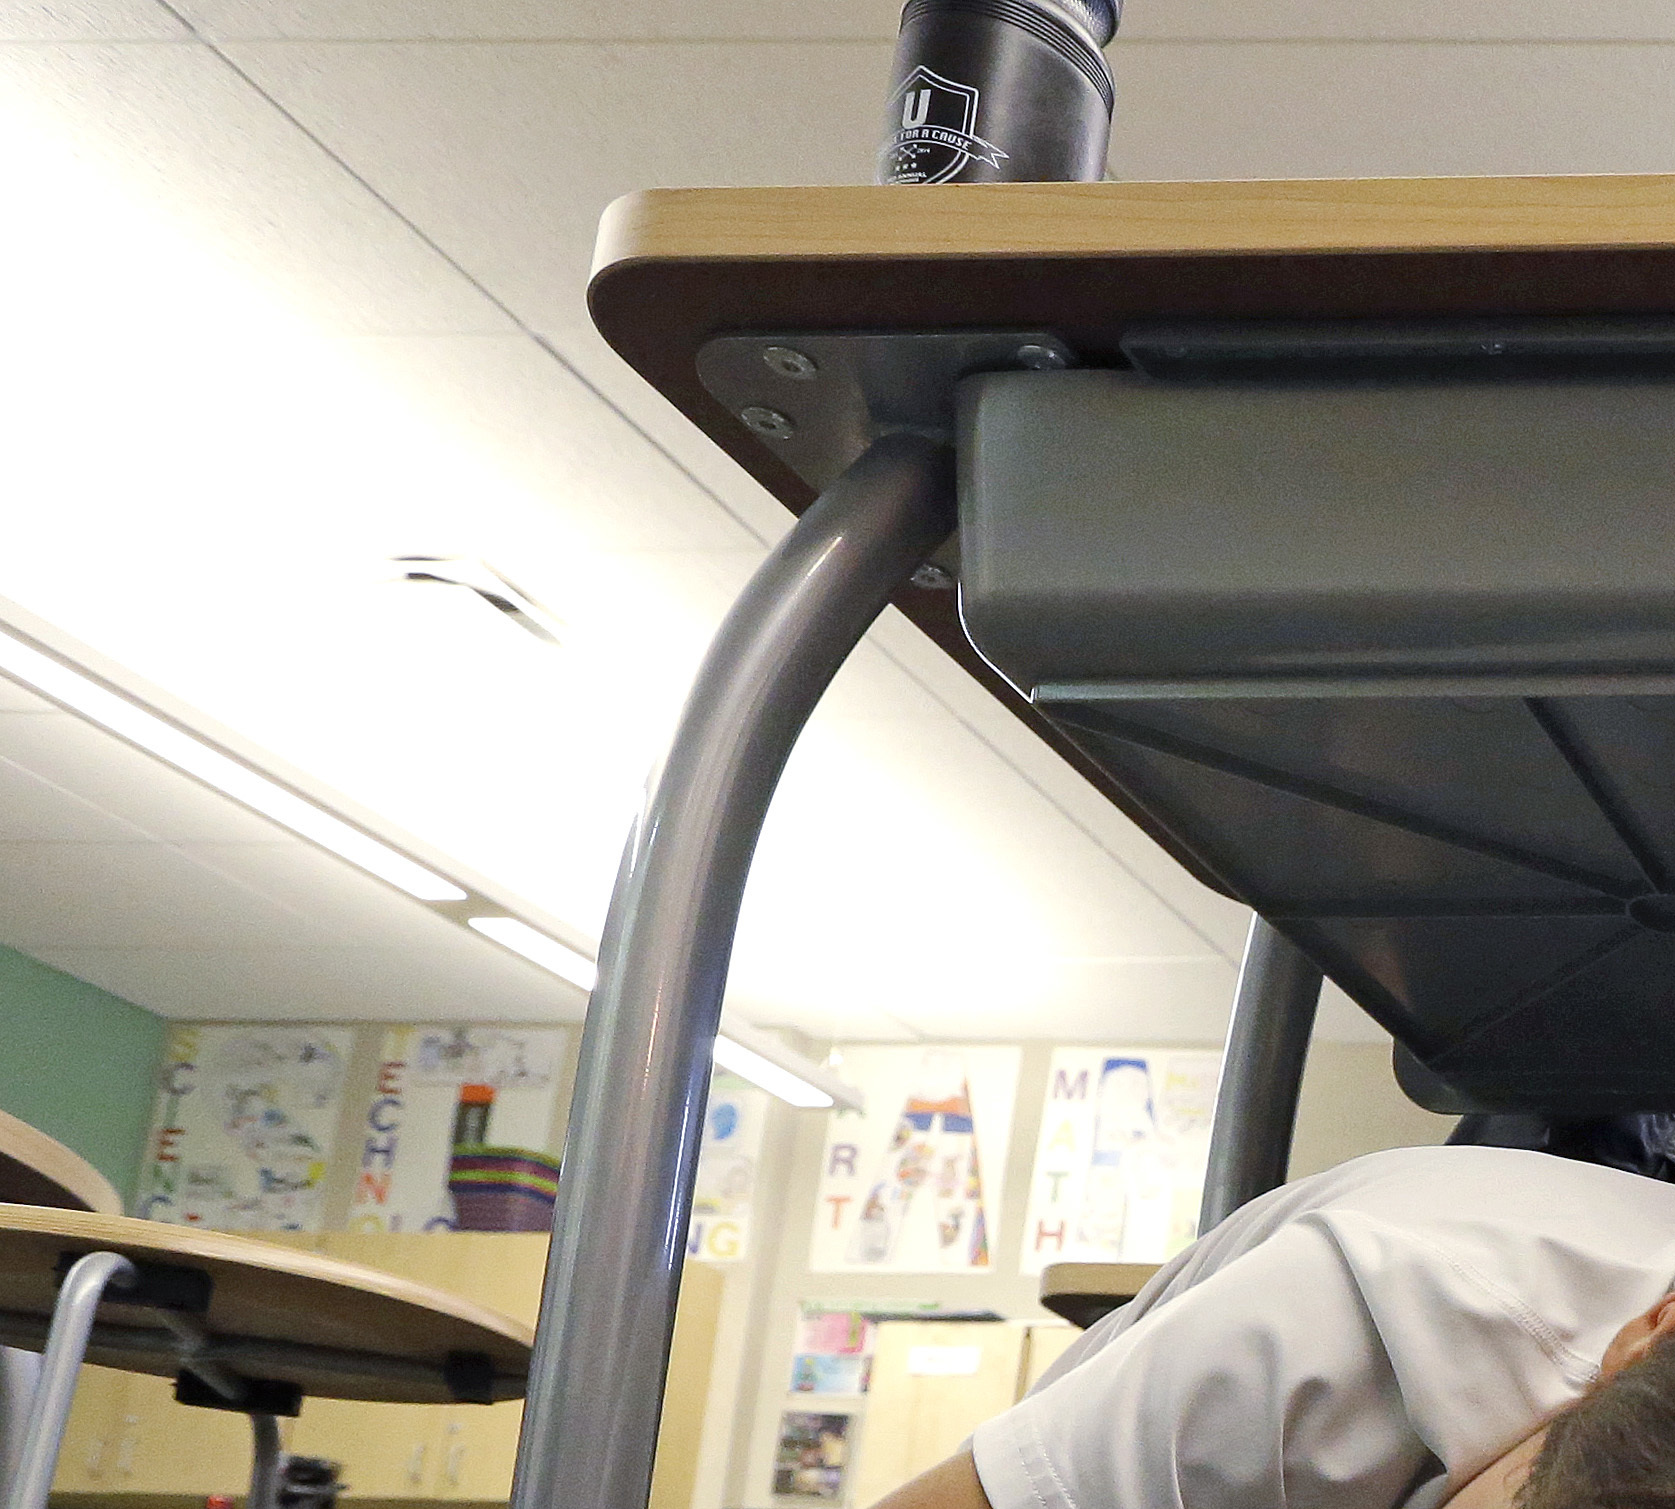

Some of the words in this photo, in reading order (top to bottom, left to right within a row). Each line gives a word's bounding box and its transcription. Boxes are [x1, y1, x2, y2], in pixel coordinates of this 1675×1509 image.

[902, 88, 932, 129] U
[921, 128, 930, 139] A
[931, 130, 973, 151] CAUSE
[137, 1026, 200, 1219] SCIENC
[1033, 1068, 1090, 1253] MATH
